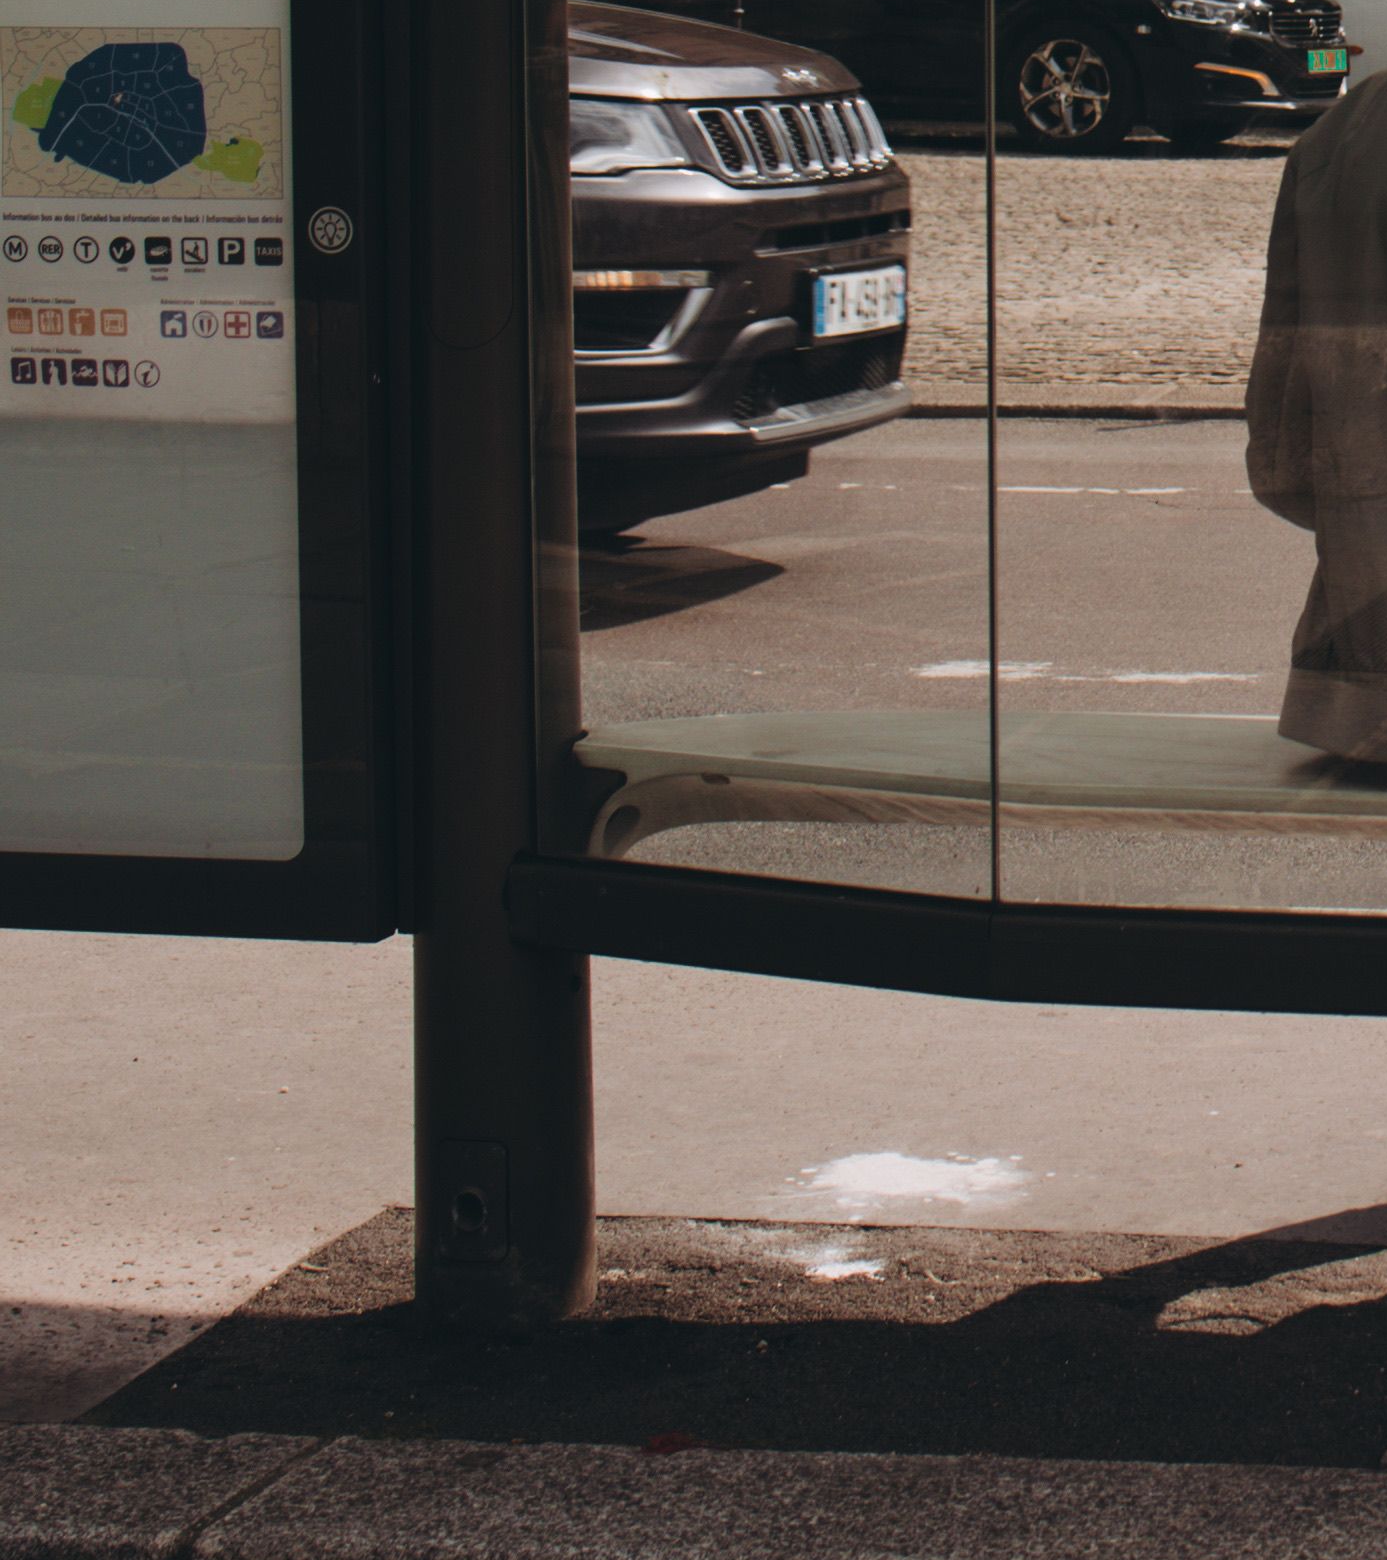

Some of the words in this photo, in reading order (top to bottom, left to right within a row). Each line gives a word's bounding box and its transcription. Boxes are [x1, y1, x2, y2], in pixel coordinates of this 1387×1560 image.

[9, 242, 22, 256] M
[42, 244, 60, 255] RER
[80, 242, 92, 258] T
[223, 240, 240, 263] P
[256, 246, 282, 257] TAXIS
